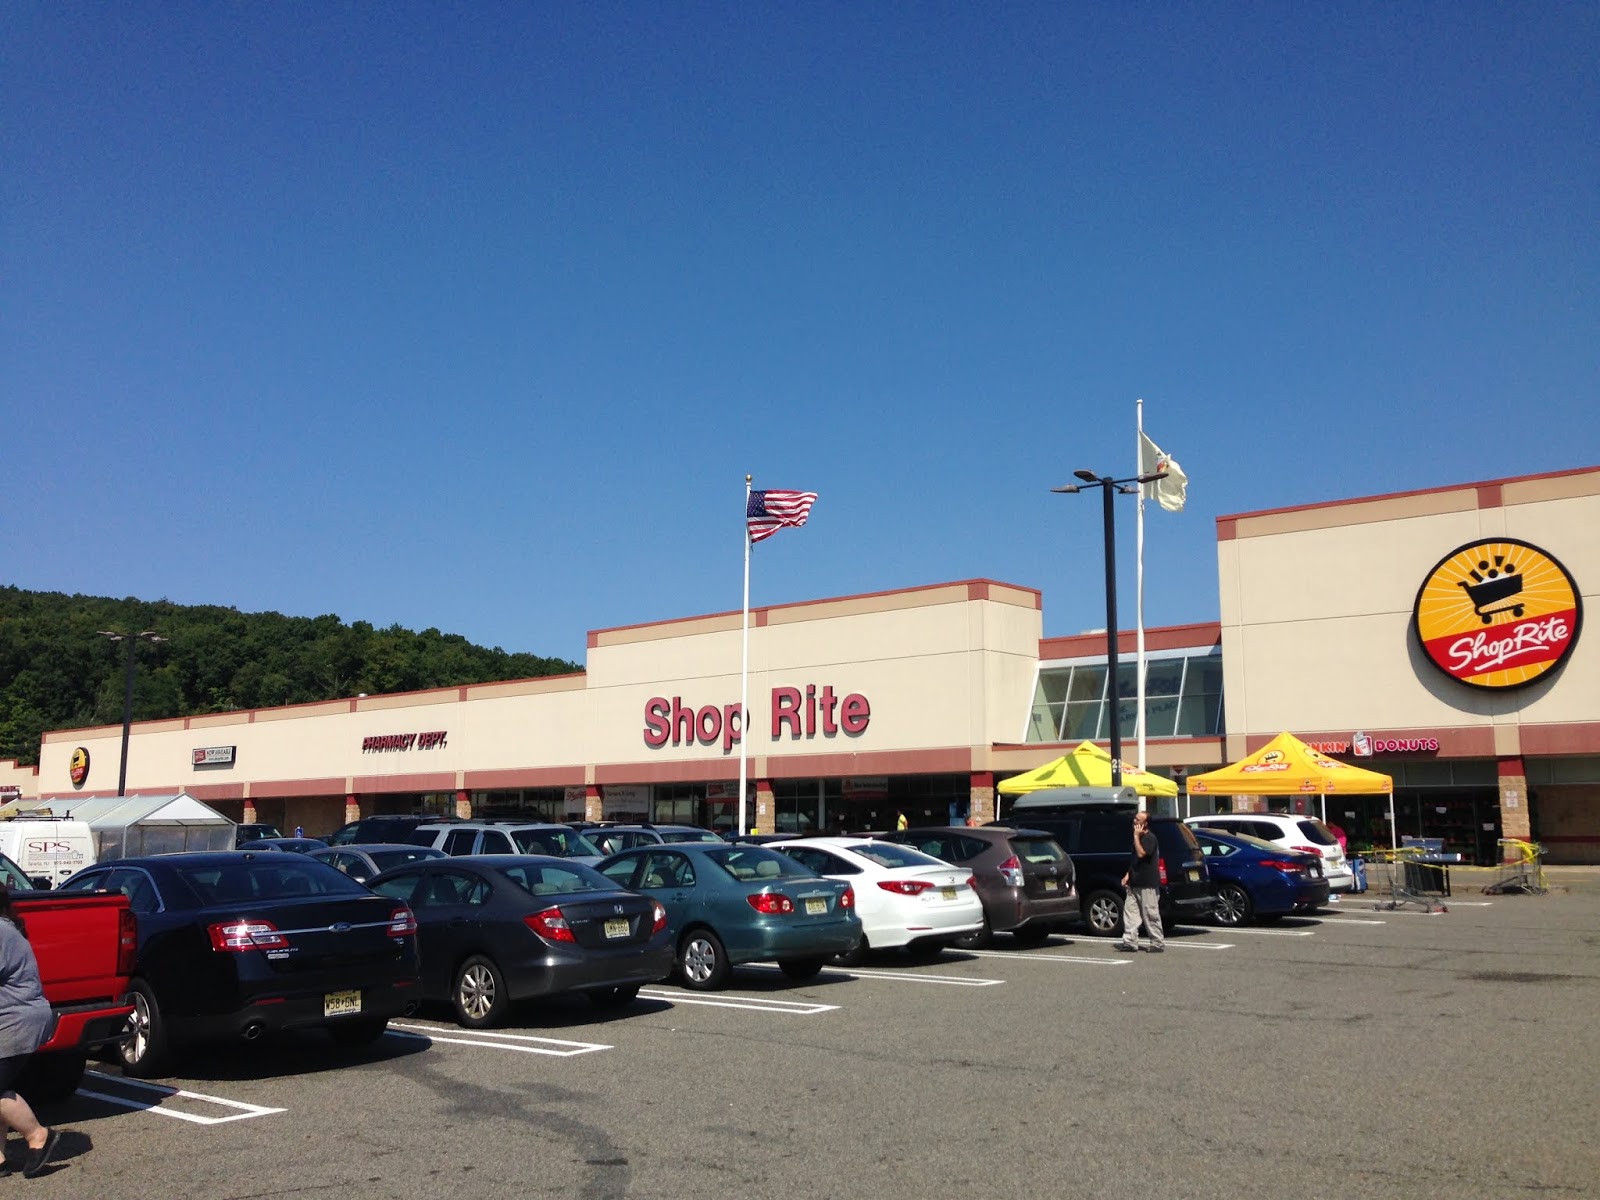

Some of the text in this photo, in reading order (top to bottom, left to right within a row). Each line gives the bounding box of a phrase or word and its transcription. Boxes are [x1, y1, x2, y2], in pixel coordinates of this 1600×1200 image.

[1448, 616, 1569, 672] ShopRite
[643, 684, 870, 752] Shop Rite
[362, 733, 417, 750] PHARMACY
[1375, 738, 1438, 752] DONUTS
[28, 841, 70, 853] SPS
